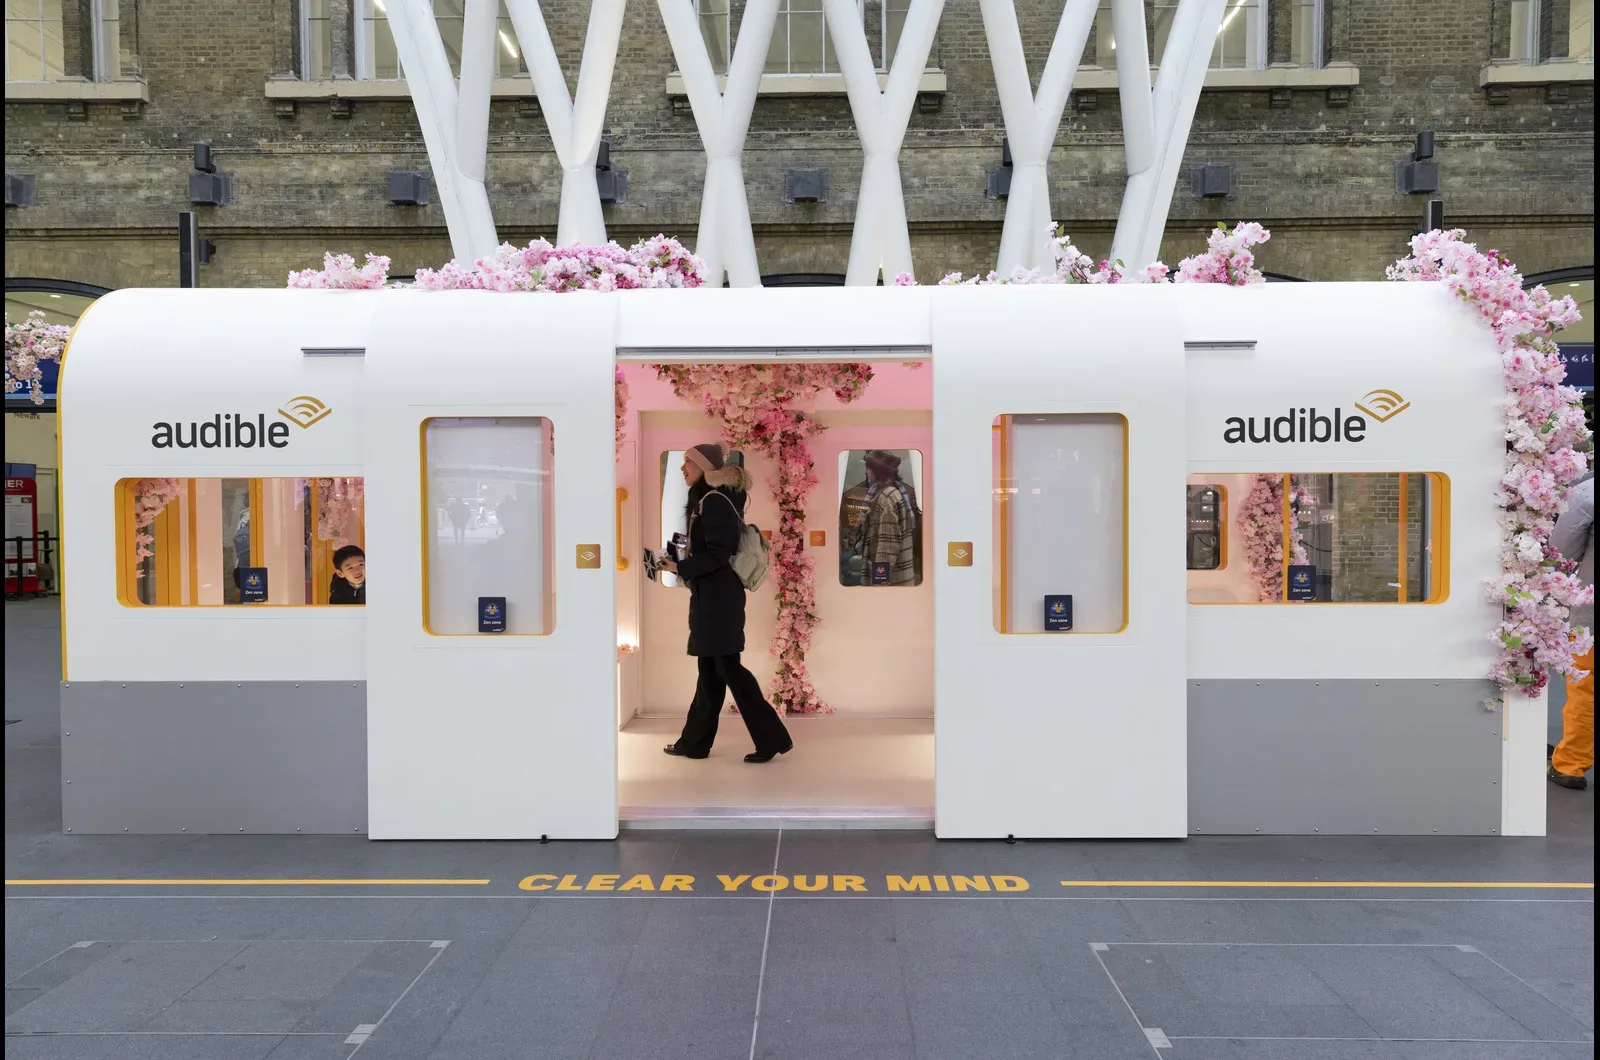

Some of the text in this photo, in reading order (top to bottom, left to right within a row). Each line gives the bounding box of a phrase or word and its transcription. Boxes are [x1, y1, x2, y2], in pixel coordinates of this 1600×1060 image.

[151, 413, 290, 449] audible
[1223, 407, 1366, 444] audible
[5, 479, 24, 489] ER
[518, 874, 1030, 892] CLEAR YOUR MIND
